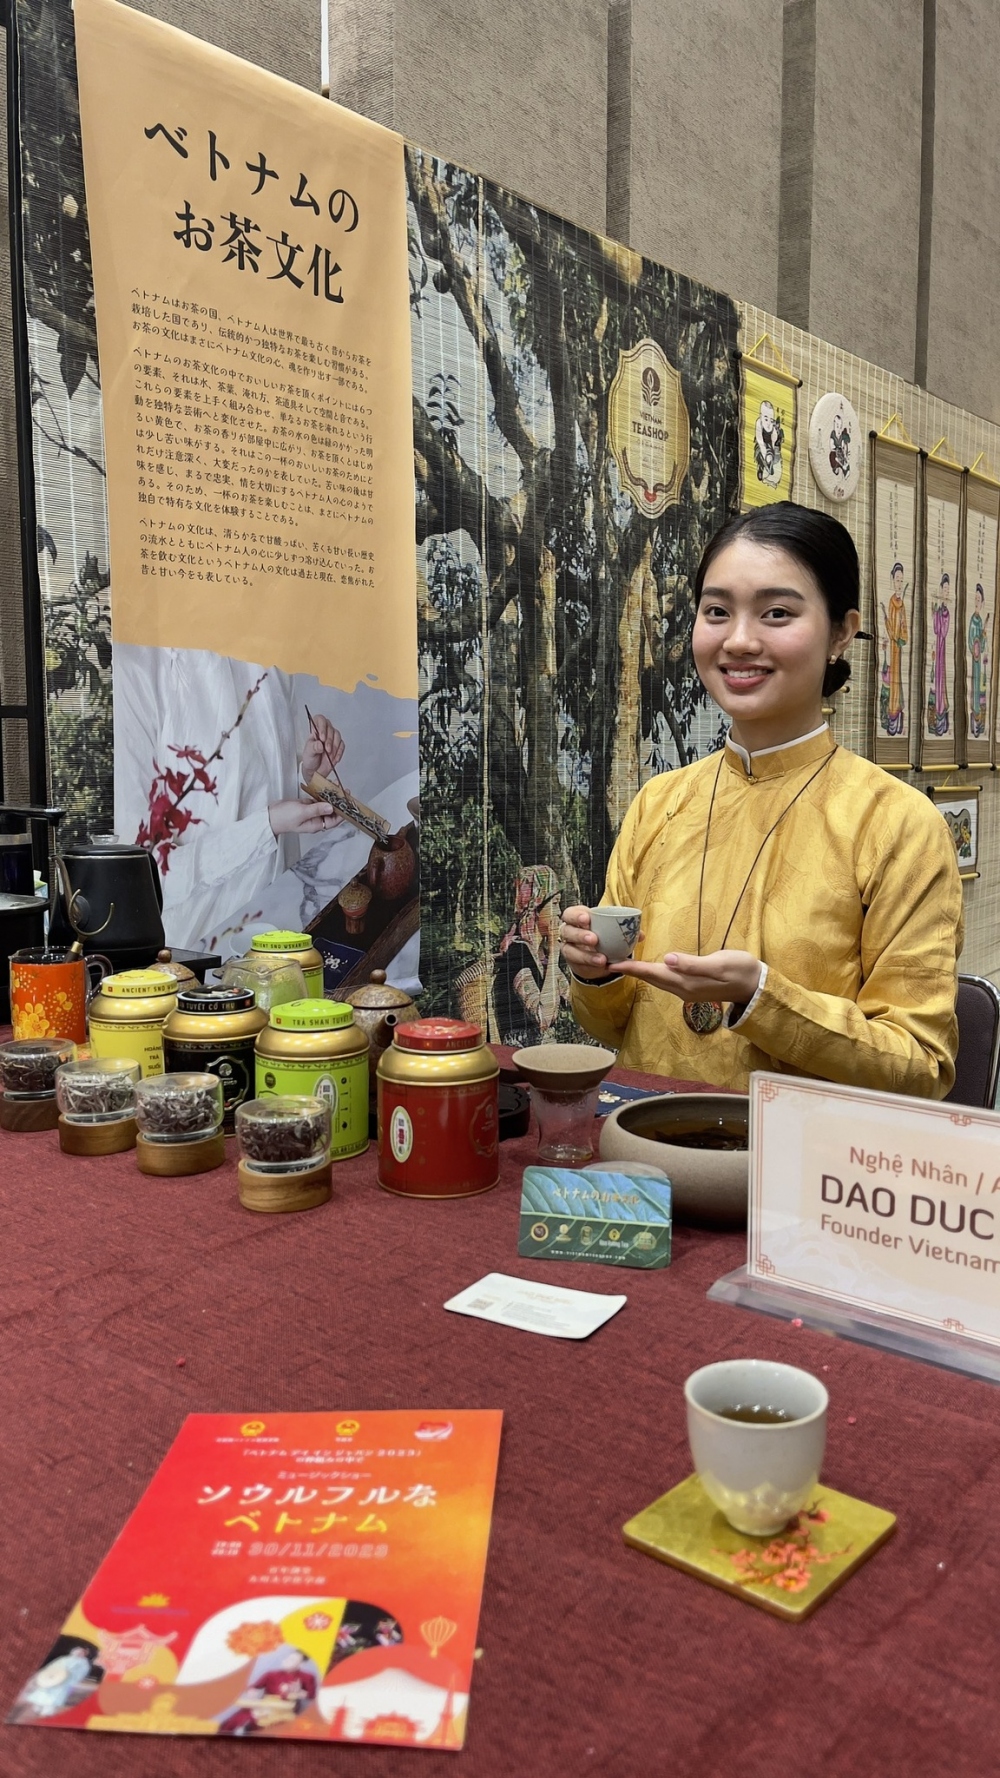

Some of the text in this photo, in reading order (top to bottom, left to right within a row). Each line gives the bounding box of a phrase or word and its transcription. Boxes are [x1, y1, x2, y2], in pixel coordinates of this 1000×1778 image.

[144, 122, 359, 232] ベトナムの
[173, 200, 344, 304] お茶文化
[632, 421, 669, 441] TEASHOP
[640, 411, 662, 424] VIETNAM
[850, 1146, 903, 1178] Nghệ
[911, 1158, 967, 1187] Nhân
[821, 1174, 994, 1240] DAO DUC
[821, 1213, 903, 1249] Founder
[277, 1470, 372, 1480] ミュージックショー
[197, 1483, 437, 1508] ソウルフルな
[224, 1510, 388, 1534] ベトナム
